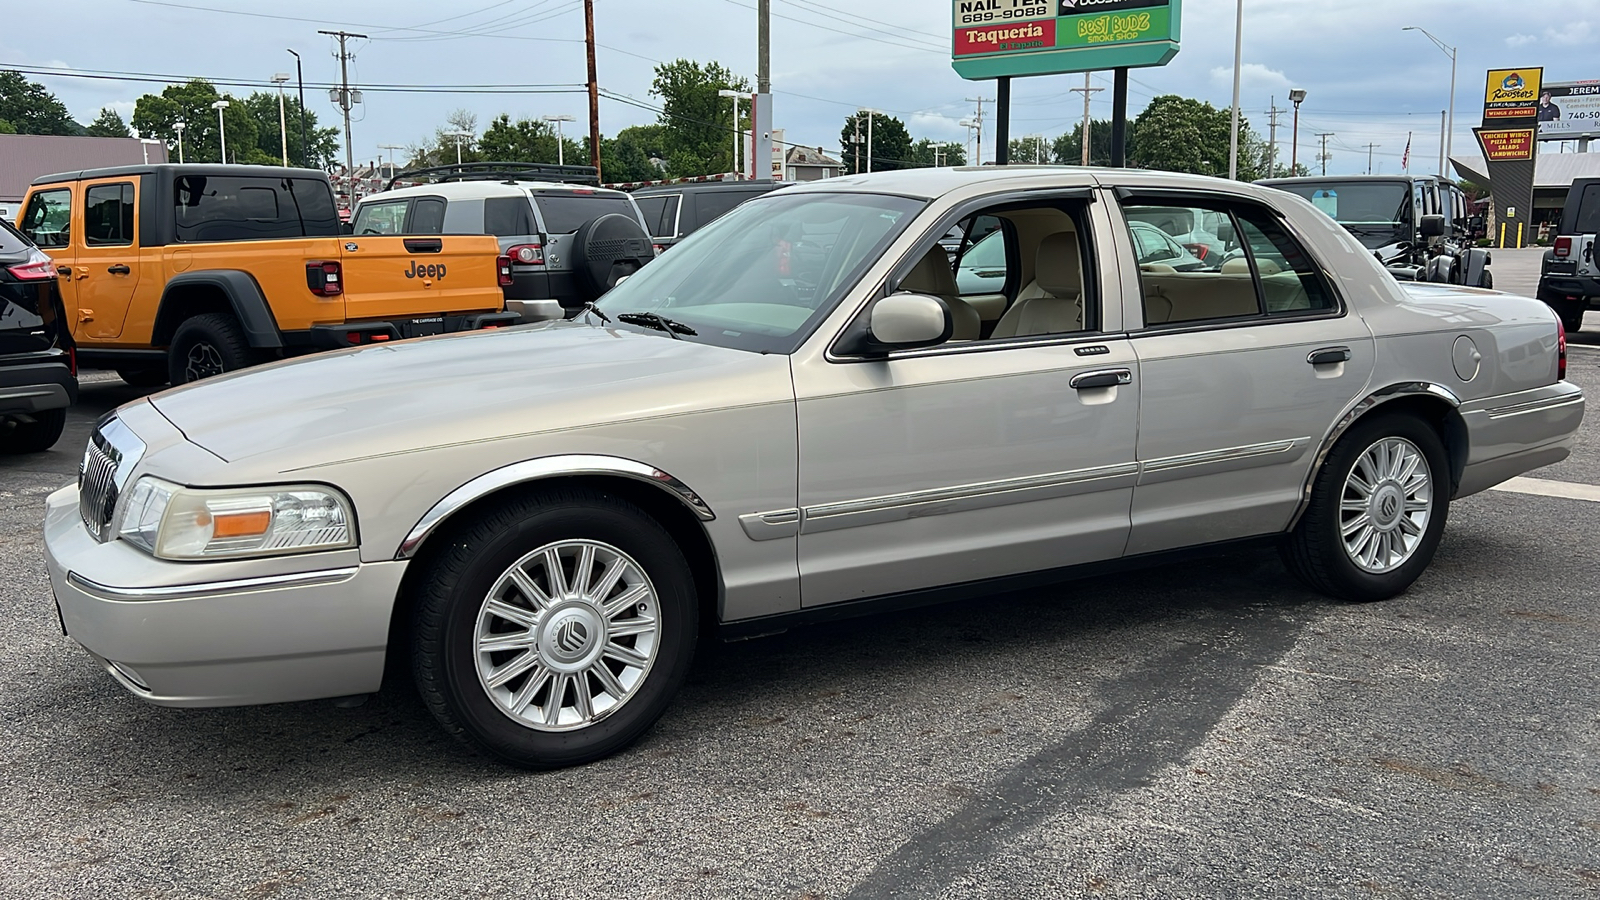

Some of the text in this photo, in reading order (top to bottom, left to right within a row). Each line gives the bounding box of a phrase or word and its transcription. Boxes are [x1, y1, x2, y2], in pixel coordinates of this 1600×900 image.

[960, 0, 1001, 13] NAIL
[962, 6, 1046, 23] 689-9088
[1088, 32, 1138, 43] SMOKE SHOP
[1492, 88, 1534, 101] Roosters
[1568, 87, 1600, 95] JEREM
[404, 260, 447, 280] Jeep
